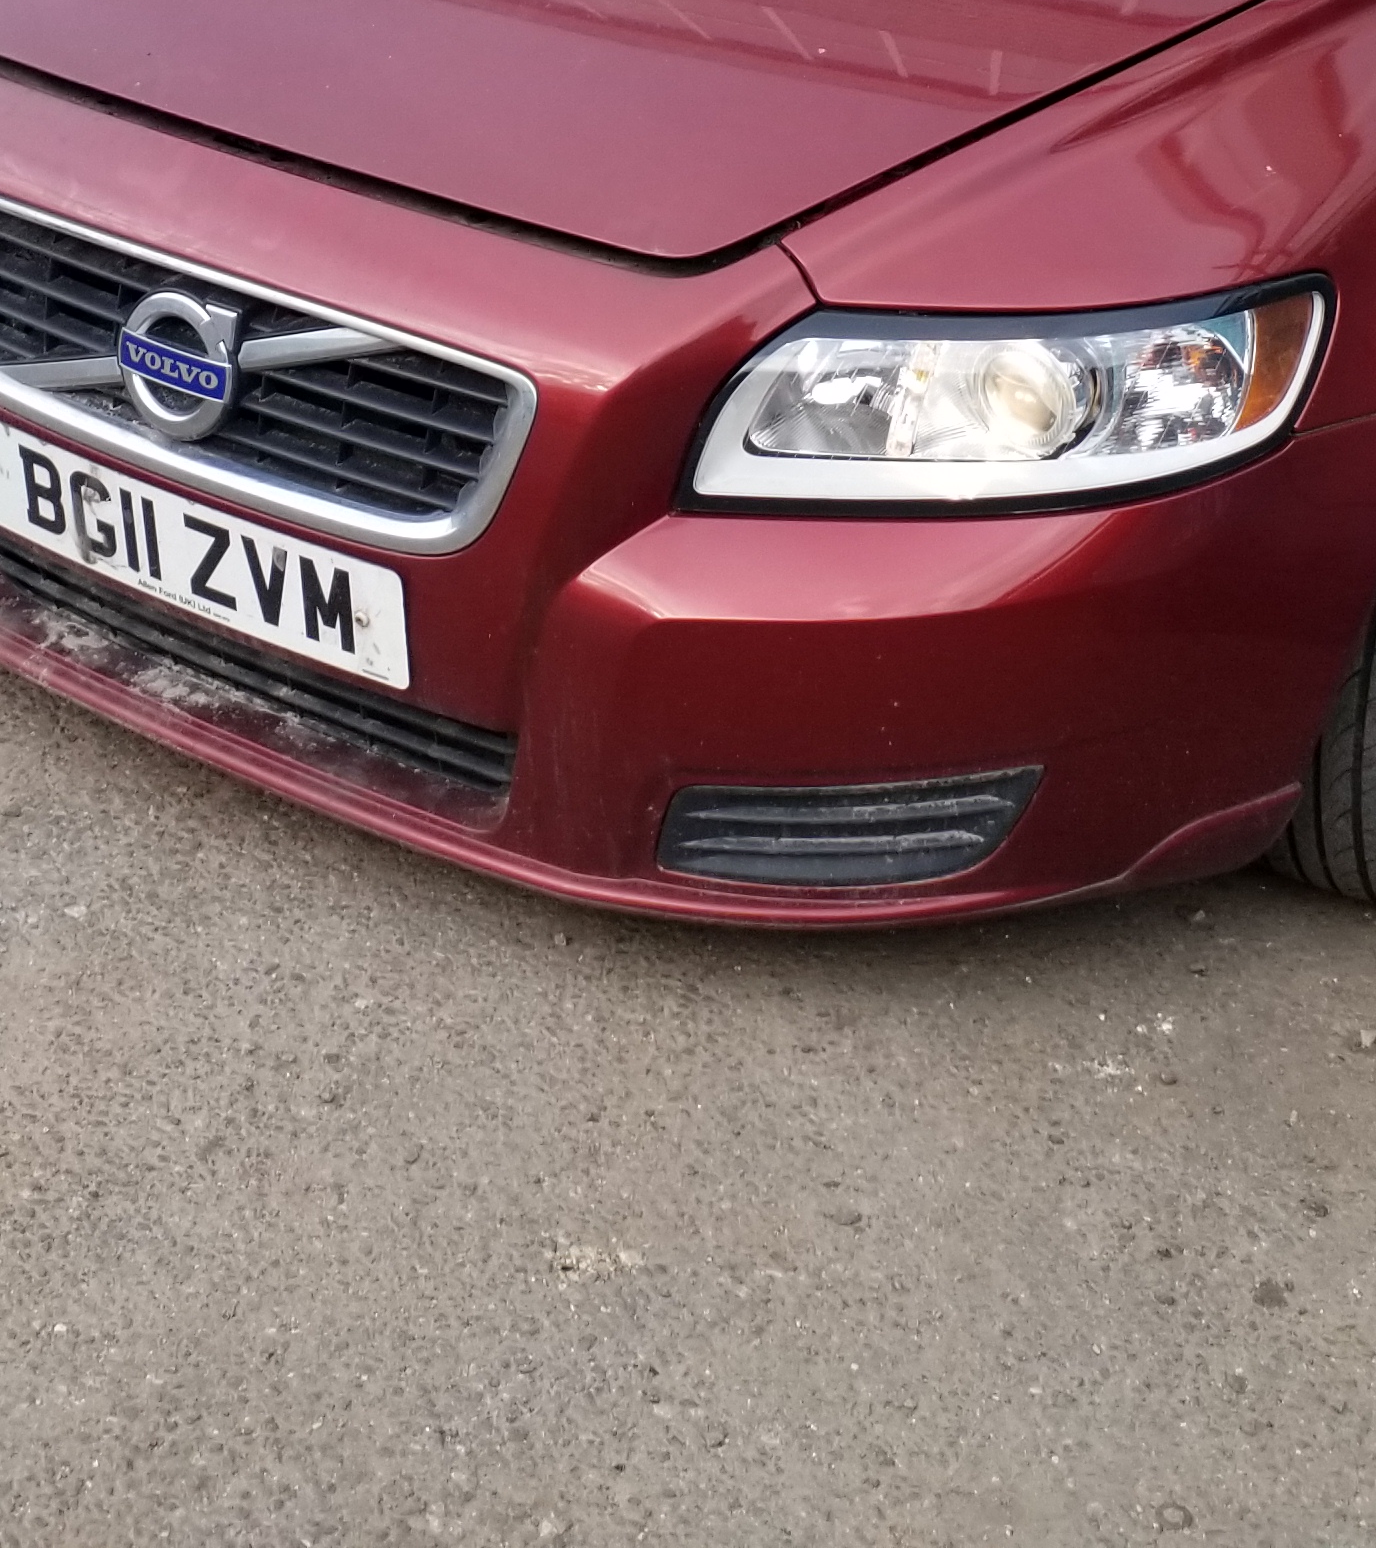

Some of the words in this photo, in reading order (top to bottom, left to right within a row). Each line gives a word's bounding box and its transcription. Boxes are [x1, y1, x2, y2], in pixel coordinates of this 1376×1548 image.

[126, 341, 219, 390] VOLVO
[159, 587, 177, 601] Ford
[179, 595, 196, 609] (UK)
[198, 602, 212, 615] Ltd
[183, 513, 356, 655] ZVM
